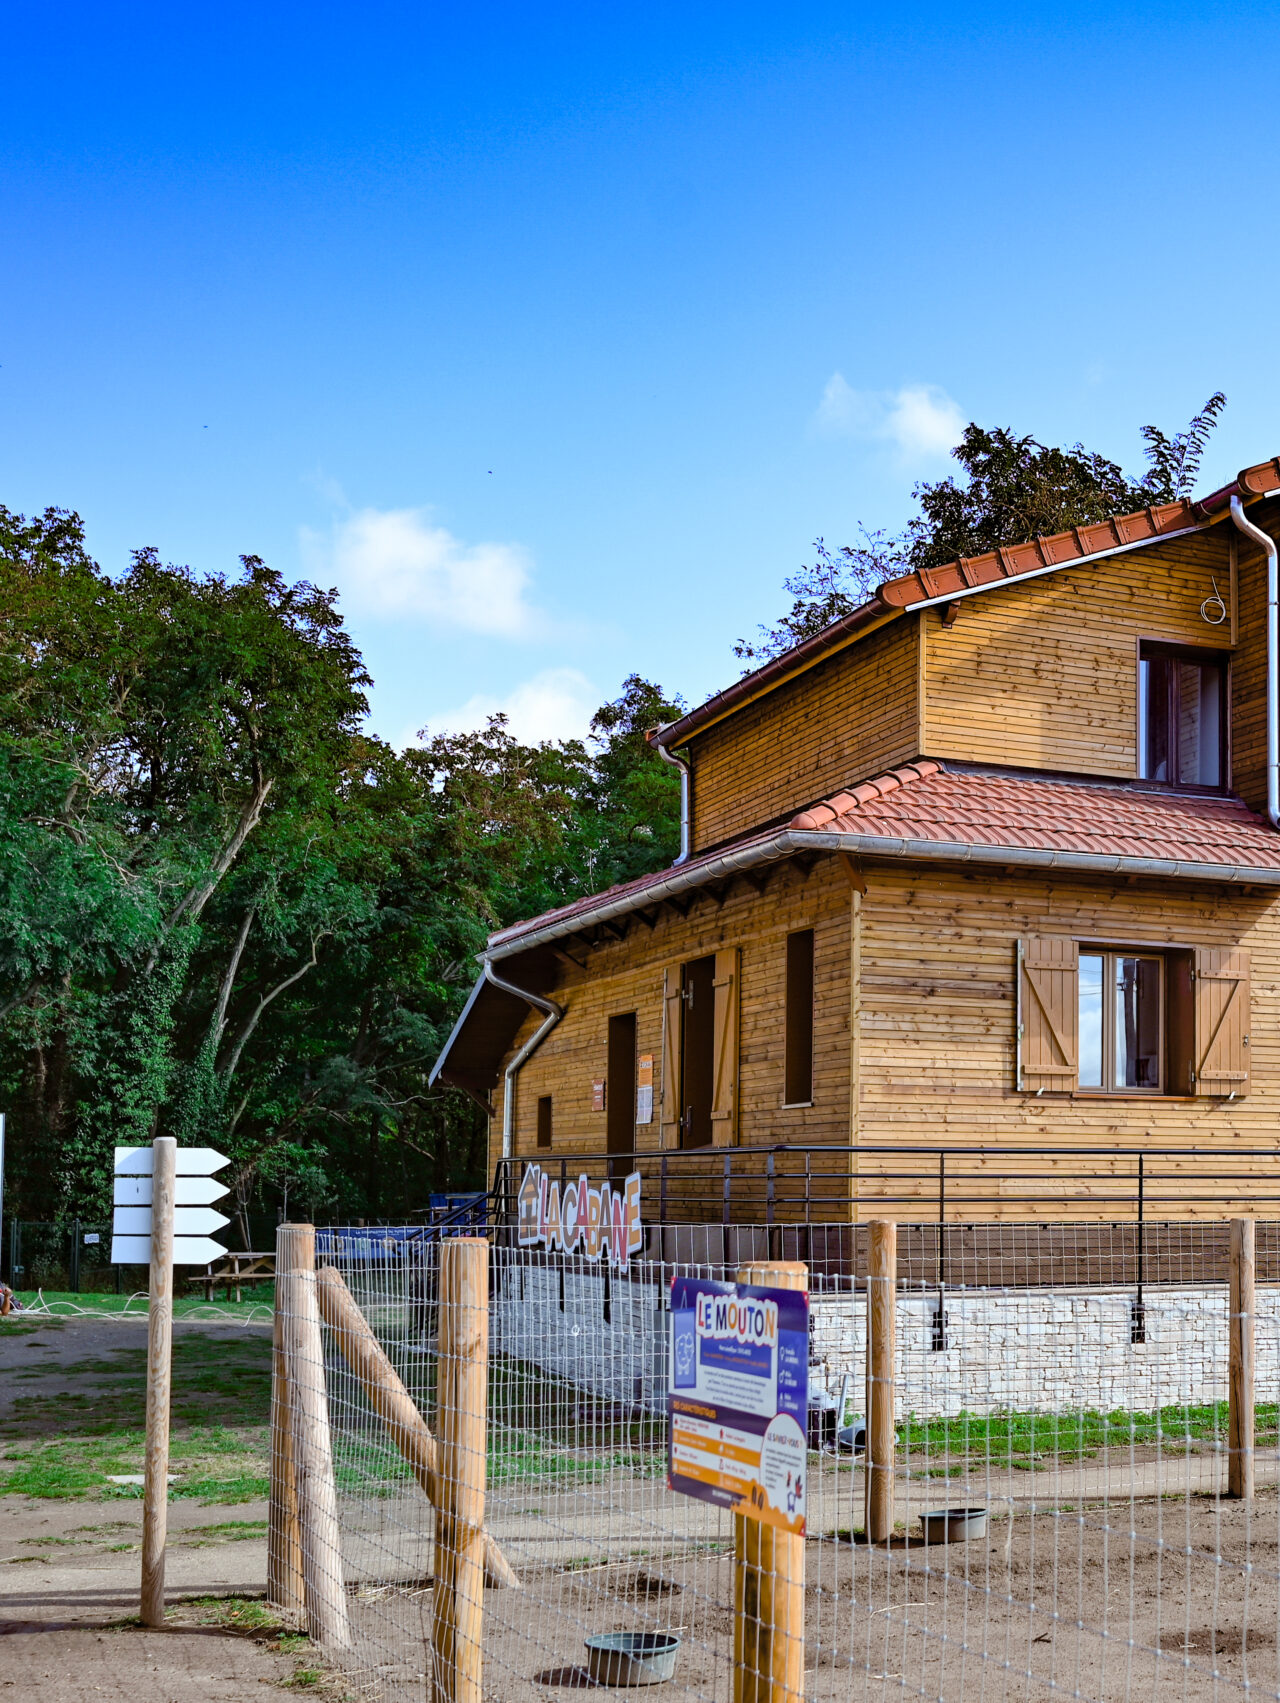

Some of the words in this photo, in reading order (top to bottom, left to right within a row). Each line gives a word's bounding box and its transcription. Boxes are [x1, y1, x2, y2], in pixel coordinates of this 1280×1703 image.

[540, 1178, 562, 1246] LA
[562, 1178, 641, 1266] CABANE
[698, 1300, 712, 1331] LE
[715, 1302, 776, 1339] MOUTON
